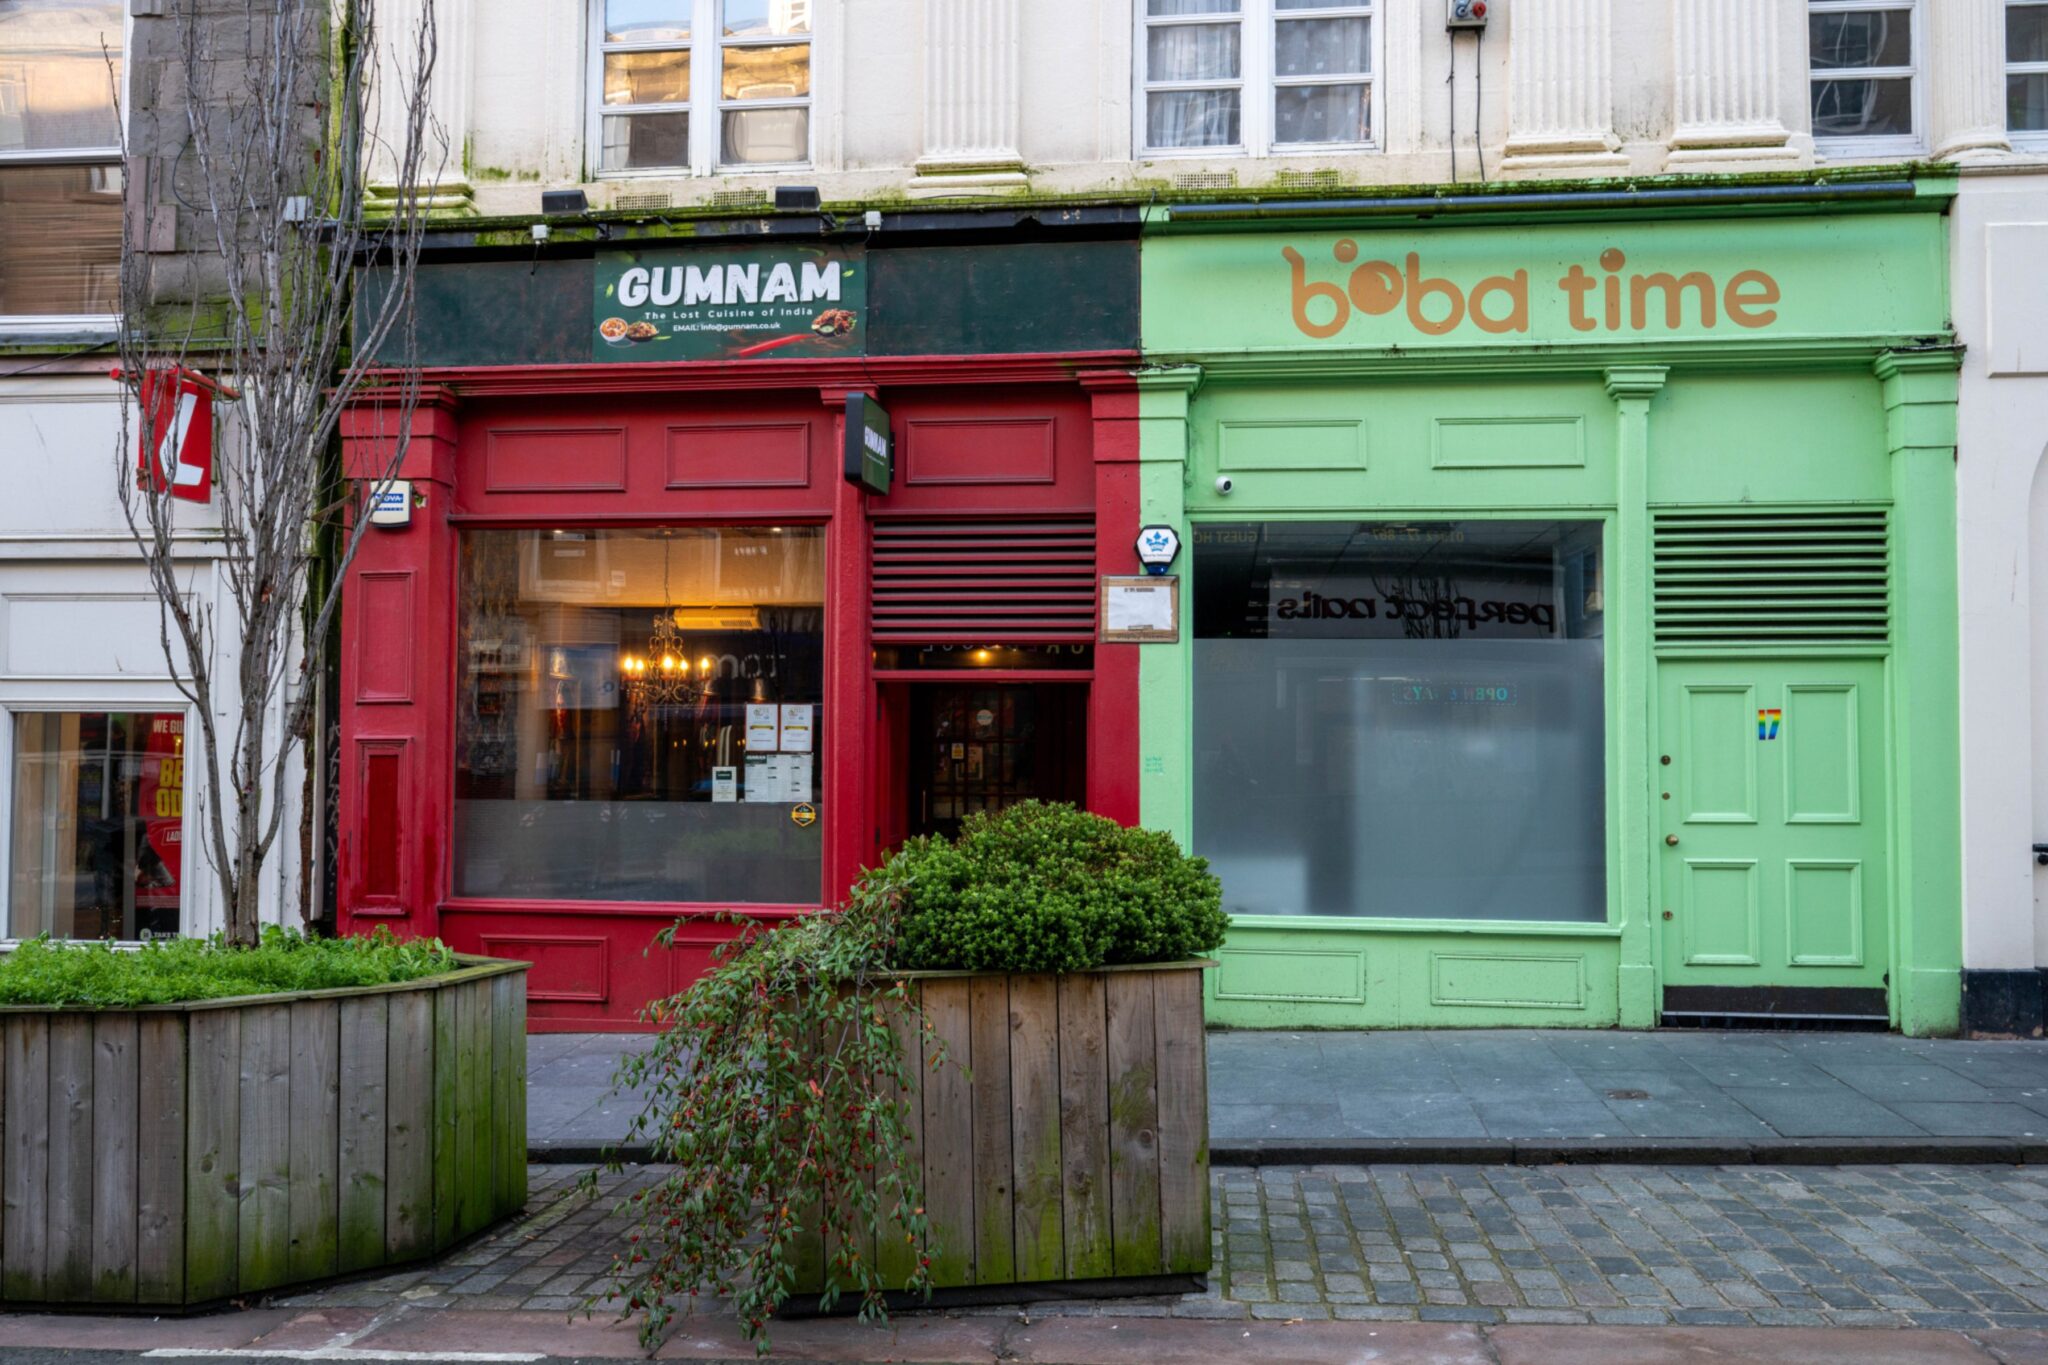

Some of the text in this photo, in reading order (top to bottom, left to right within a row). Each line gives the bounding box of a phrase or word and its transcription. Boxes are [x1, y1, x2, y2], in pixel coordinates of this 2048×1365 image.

[618, 261, 841, 307] GUMNAM
[1282, 243, 1781, 339] boba time
[645, 307, 813, 320] The Lost Cuisine of India
[701, 321, 781, 332] info@gumnam.co.uk
[153, 719, 168, 734] WE
[1758, 709, 1781, 740] 17
